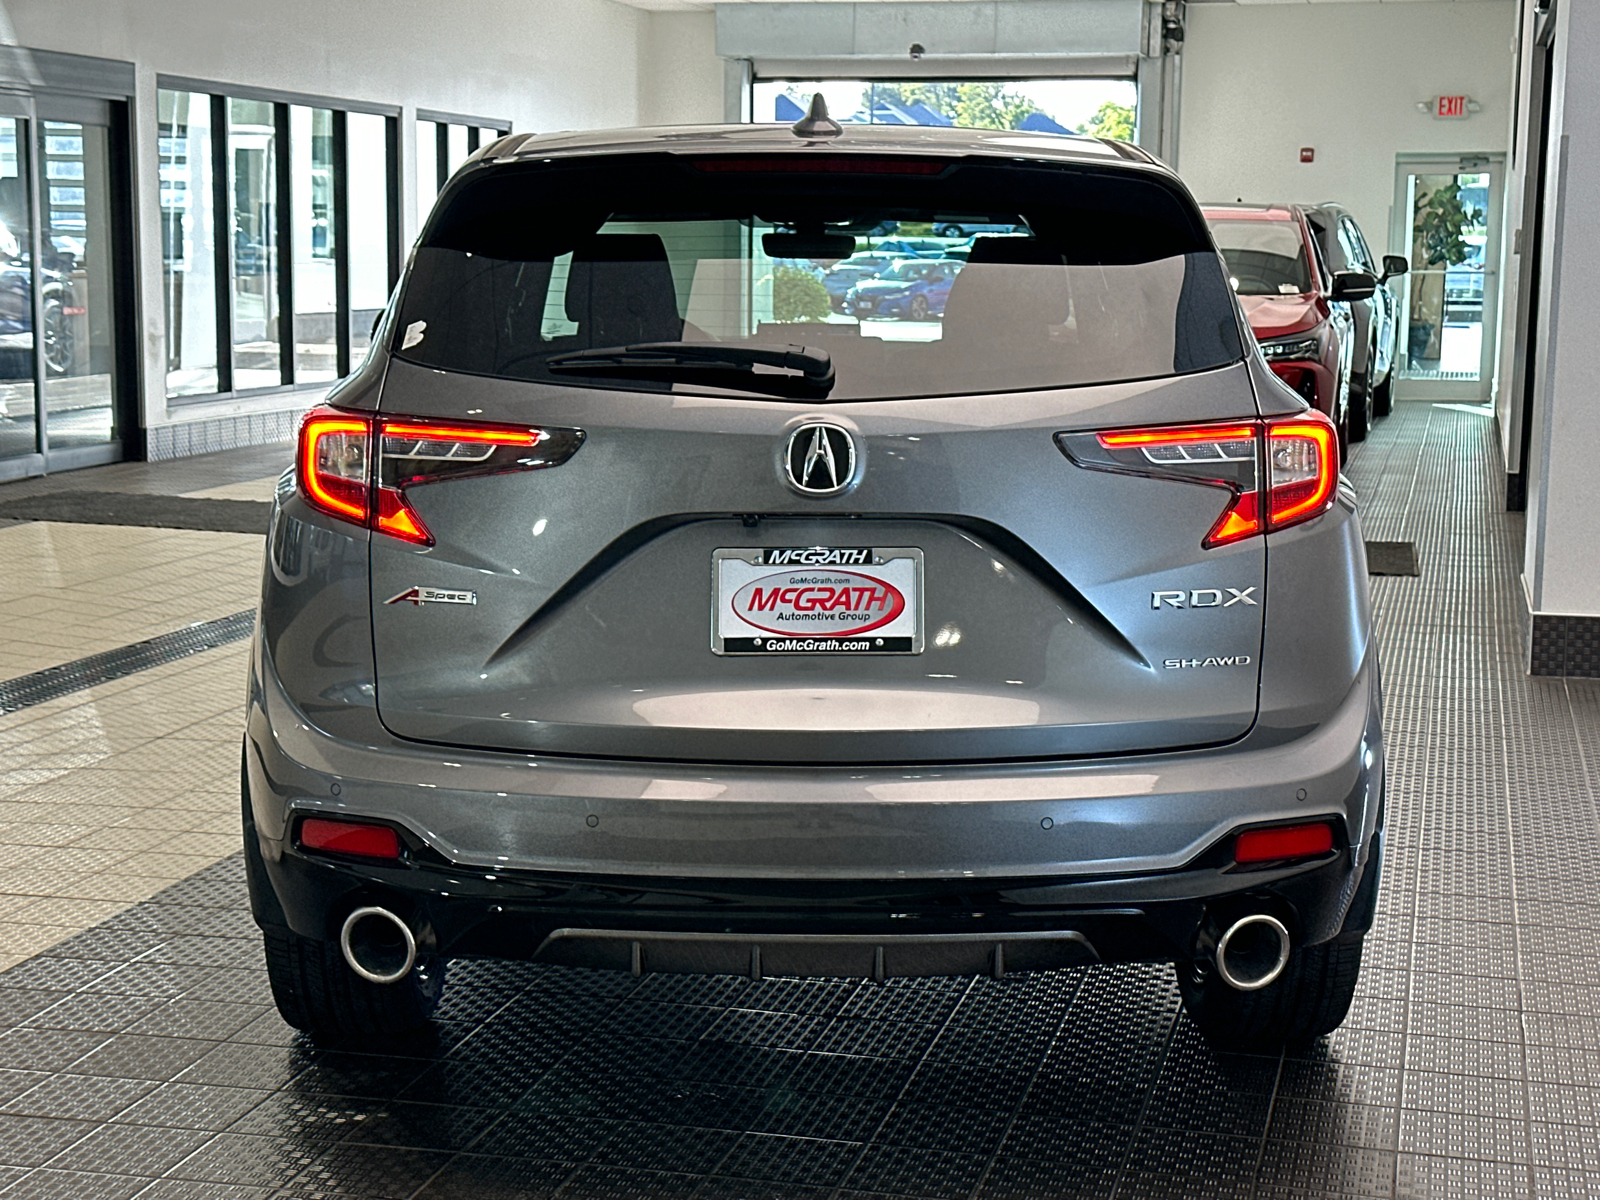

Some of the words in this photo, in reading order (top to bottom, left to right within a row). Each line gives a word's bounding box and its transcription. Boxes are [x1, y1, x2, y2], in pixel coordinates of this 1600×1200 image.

[1438, 96, 1465, 116] EXIT
[1151, 586, 1258, 610] RDX
[776, 611, 836, 621] Automotive
[838, 611, 871, 622] Group
[766, 640, 870, 651] GoMcGrath.com
[1163, 655, 1251, 669] SH-AWD
